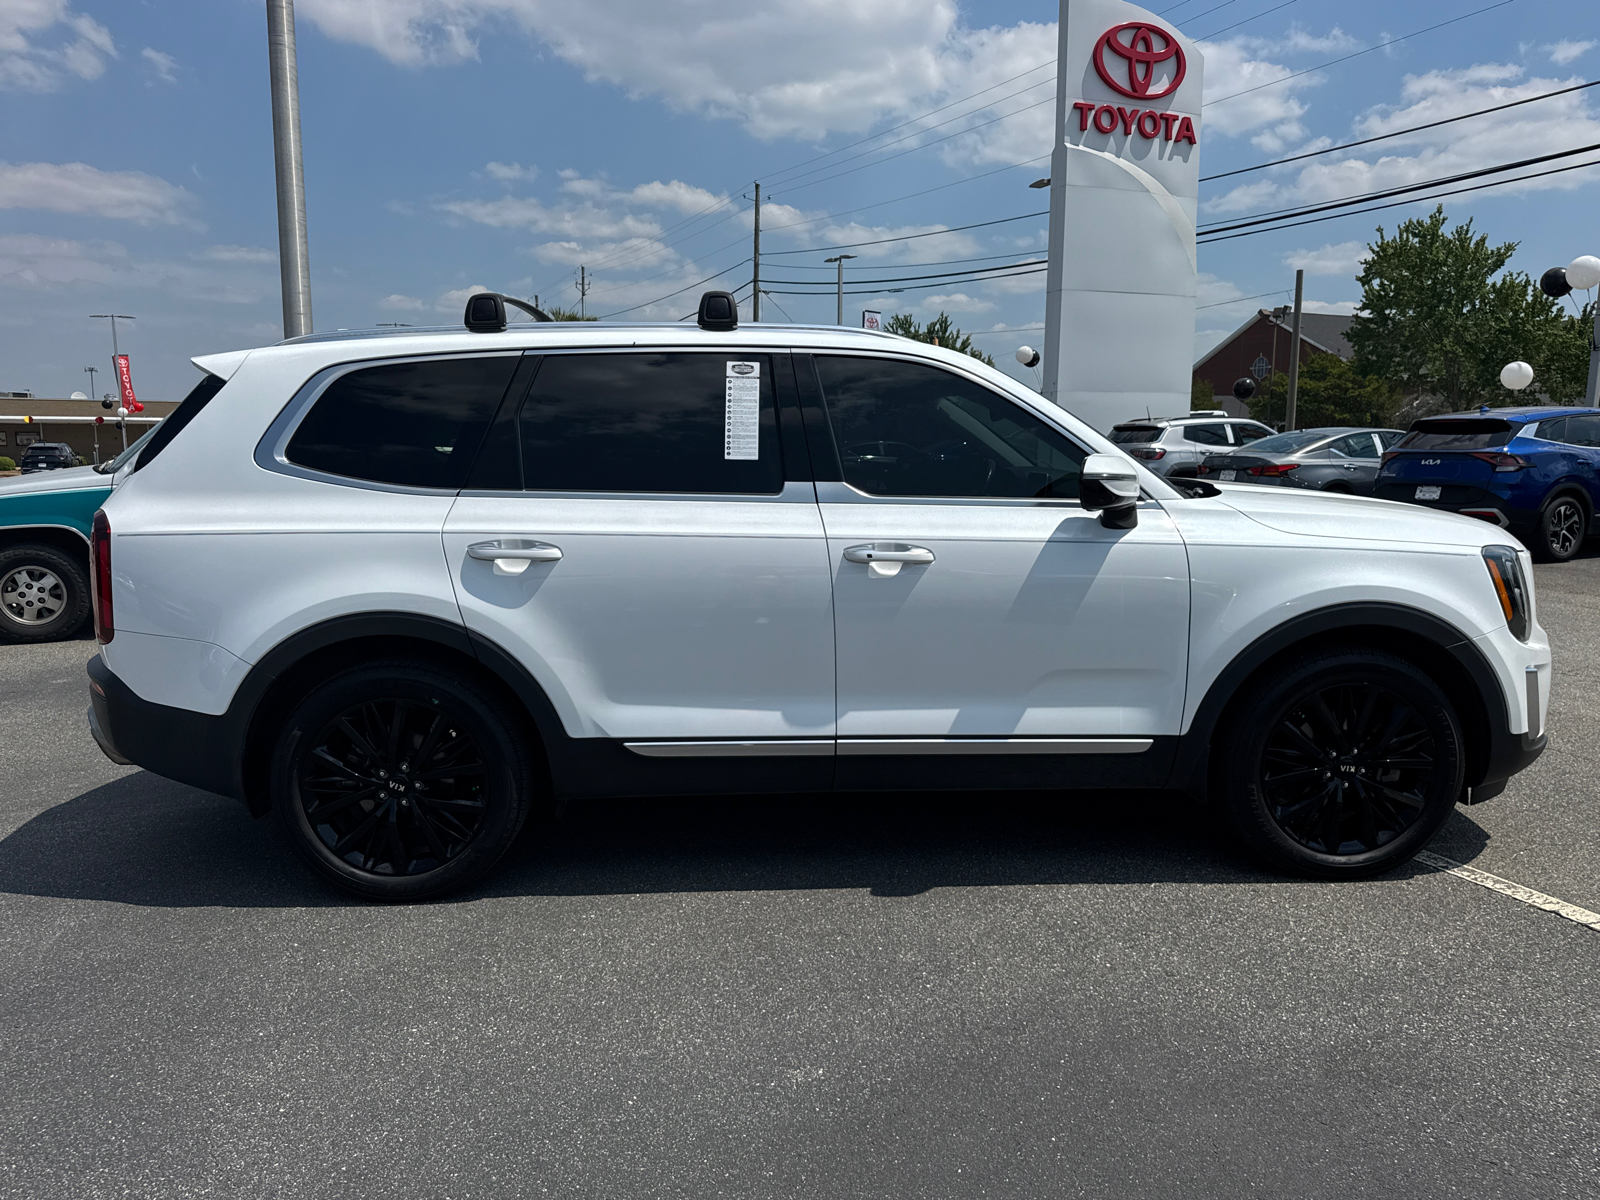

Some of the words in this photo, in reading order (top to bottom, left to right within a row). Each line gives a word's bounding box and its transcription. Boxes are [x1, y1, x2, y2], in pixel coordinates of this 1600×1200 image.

[1073, 102, 1197, 144] TOYOTA
[121, 367, 135, 411] TOYOTA
[389, 780, 405, 792] KIA
